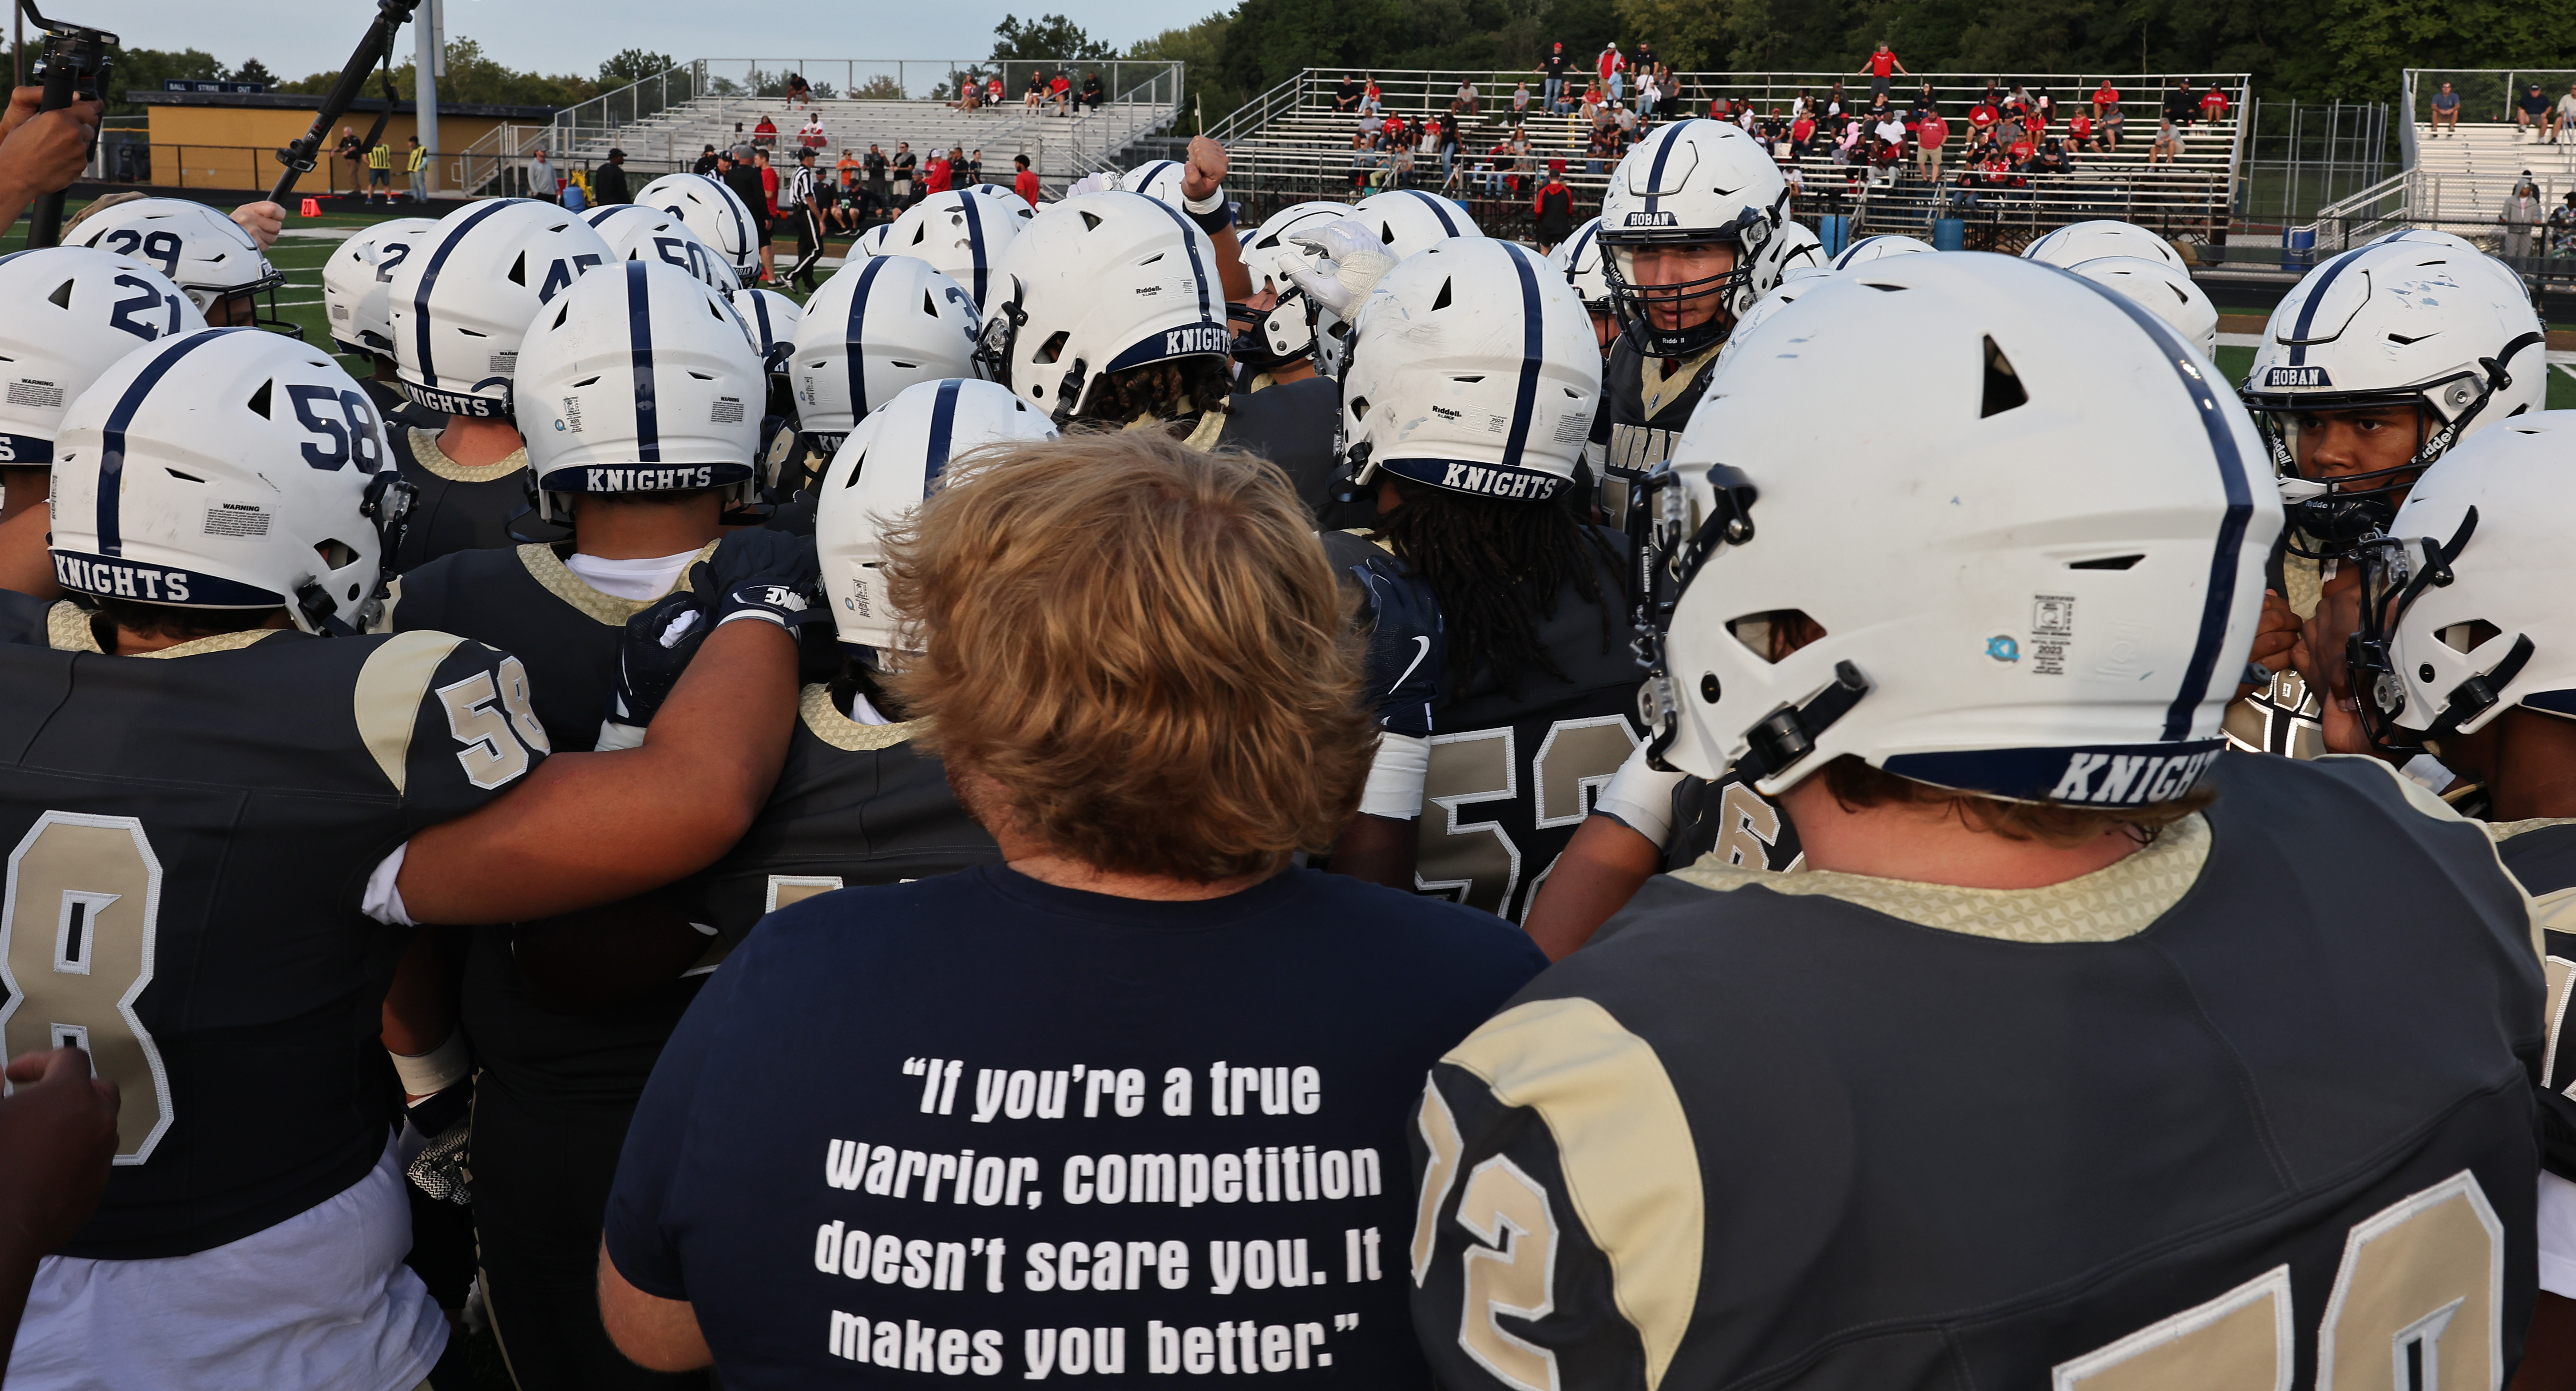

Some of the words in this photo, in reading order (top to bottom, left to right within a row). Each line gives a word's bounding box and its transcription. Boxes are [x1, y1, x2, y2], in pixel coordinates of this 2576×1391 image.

[304, 201, 311, 214] 20
[1630, 213, 1669, 225] HOBAN
[107, 230, 182, 278] 29
[735, 267, 751, 275] OBAN
[110, 274, 181, 342] 21
[1166, 328, 1232, 355] KNIGHTS
[22, 378, 54, 386] WARNING
[2271, 369, 2319, 386] HOBAN
[403, 382, 490, 417] KNIGHTS
[285, 385, 384, 475] 58
[587, 466, 712, 493] KNIGHTS
[1442, 462, 1557, 500] KNIGHTS
[223, 503, 259, 512] WARNING
[2306, 500, 2335, 509] Riddel
[55, 554, 190, 601] KNIGHTS
[764, 587, 808, 612] NIKE
[435, 656, 551, 790] 58
[903, 1057, 964, 1115] “If
[971, 1064, 1145, 1123] you’re
[1163, 1068, 1192, 1116] a
[1210, 1061, 1320, 1116] true
[826, 1139, 1042, 1210] warrior,
[1063, 1146, 1381, 1208] competition
[815, 1220, 1006, 1293] doesn’t
[1025, 1240, 1189, 1291] scare
[1210, 1239, 1326, 1295] you.
[1346, 1227, 1381, 1283] It
[829, 1310, 1003, 1376] makes
[1024, 1327, 1125, 1380] you
[1148, 1313, 1359, 1374] better.”
